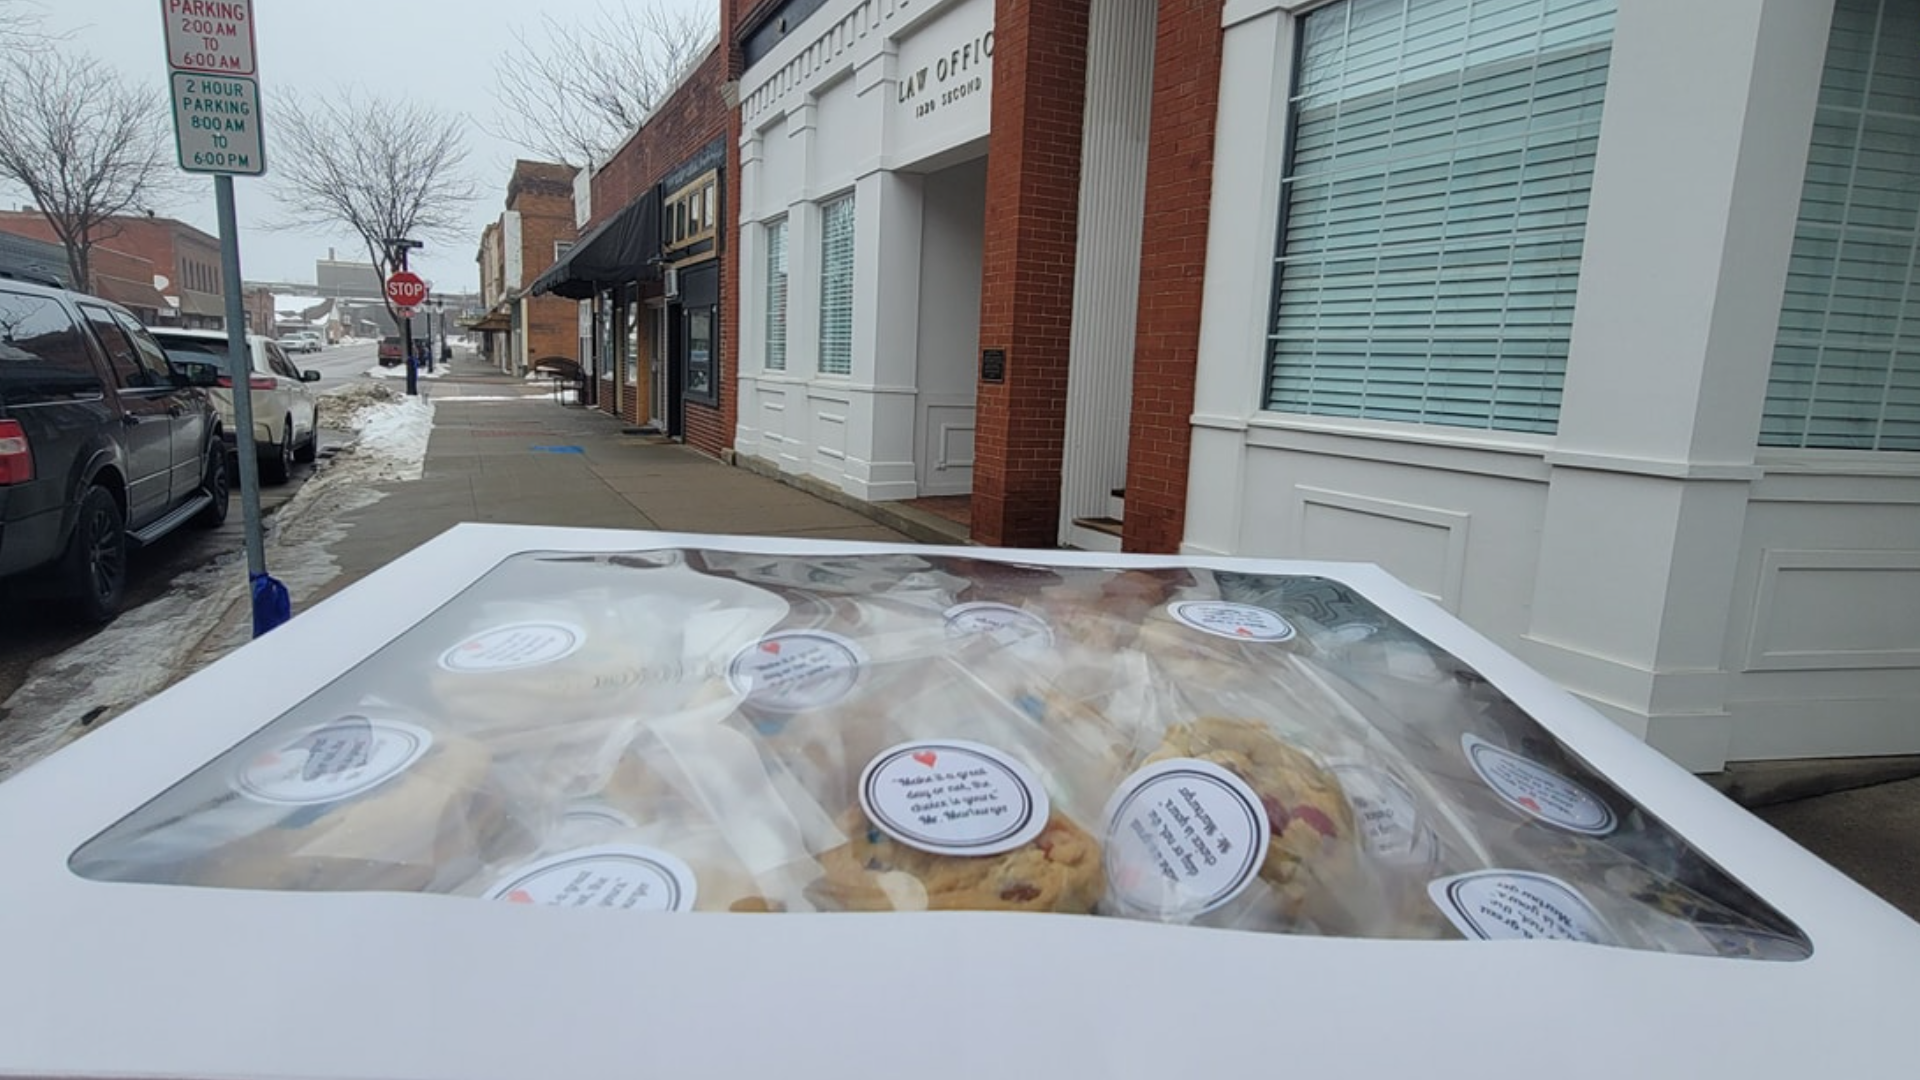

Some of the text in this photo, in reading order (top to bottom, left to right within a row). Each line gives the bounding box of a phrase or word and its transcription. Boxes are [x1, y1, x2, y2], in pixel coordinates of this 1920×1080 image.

[170, 0, 244, 21] PARKING
[182, 19, 237, 36] 2:00 AM
[203, 37, 218, 51] TO
[184, 53, 240, 69] 6:00 AM
[187, 80, 243, 97] 2 HOUR
[899, 67, 928, 103] LAW
[942, 77, 982, 106] SECOND
[183, 97, 250, 115] PARKING
[191, 115, 245, 132] 8:00 AM
[212, 134, 227, 149] TO
[194, 152, 249, 167] 6:00 PM
[389, 282, 423, 297] STOP
